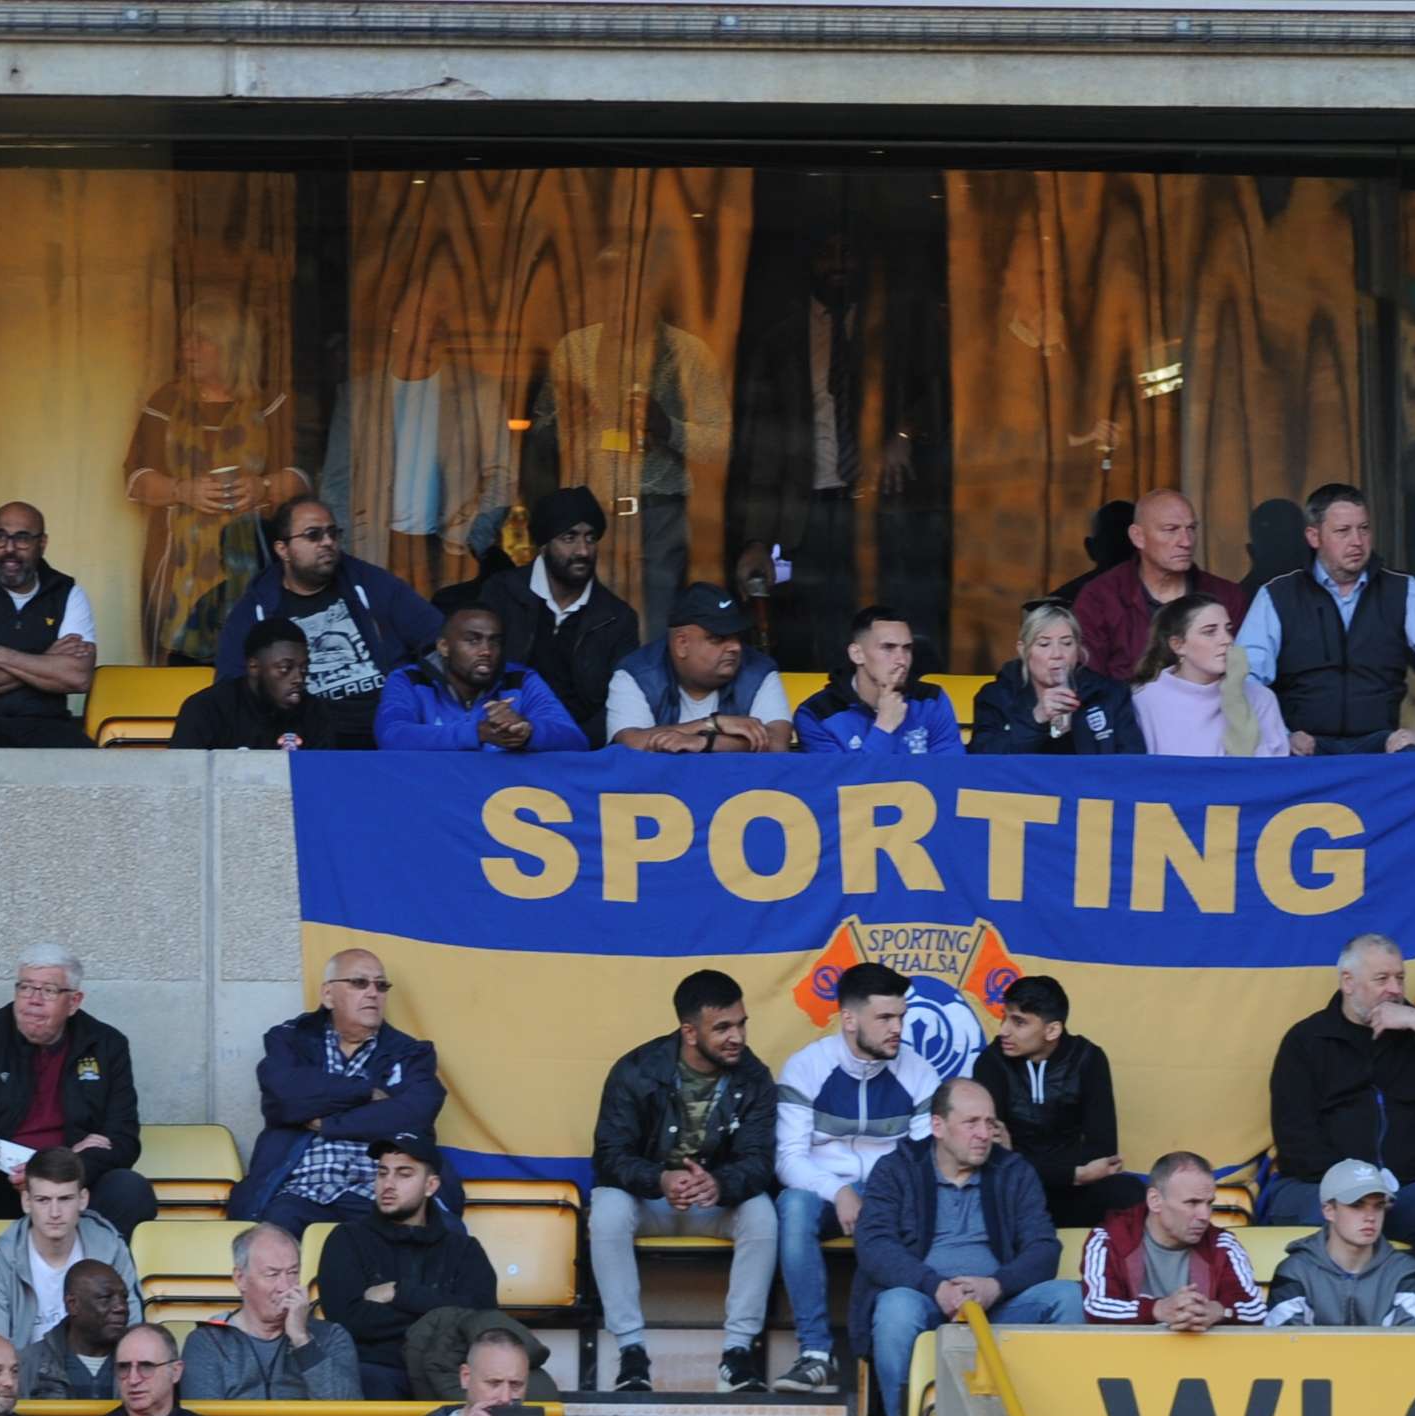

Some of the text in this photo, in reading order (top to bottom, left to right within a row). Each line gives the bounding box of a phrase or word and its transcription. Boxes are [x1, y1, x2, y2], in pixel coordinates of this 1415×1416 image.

[479, 780, 1367, 917] SPORTING
[868, 928, 971, 954] SPORTING
[877, 952, 960, 975] KHALSA
